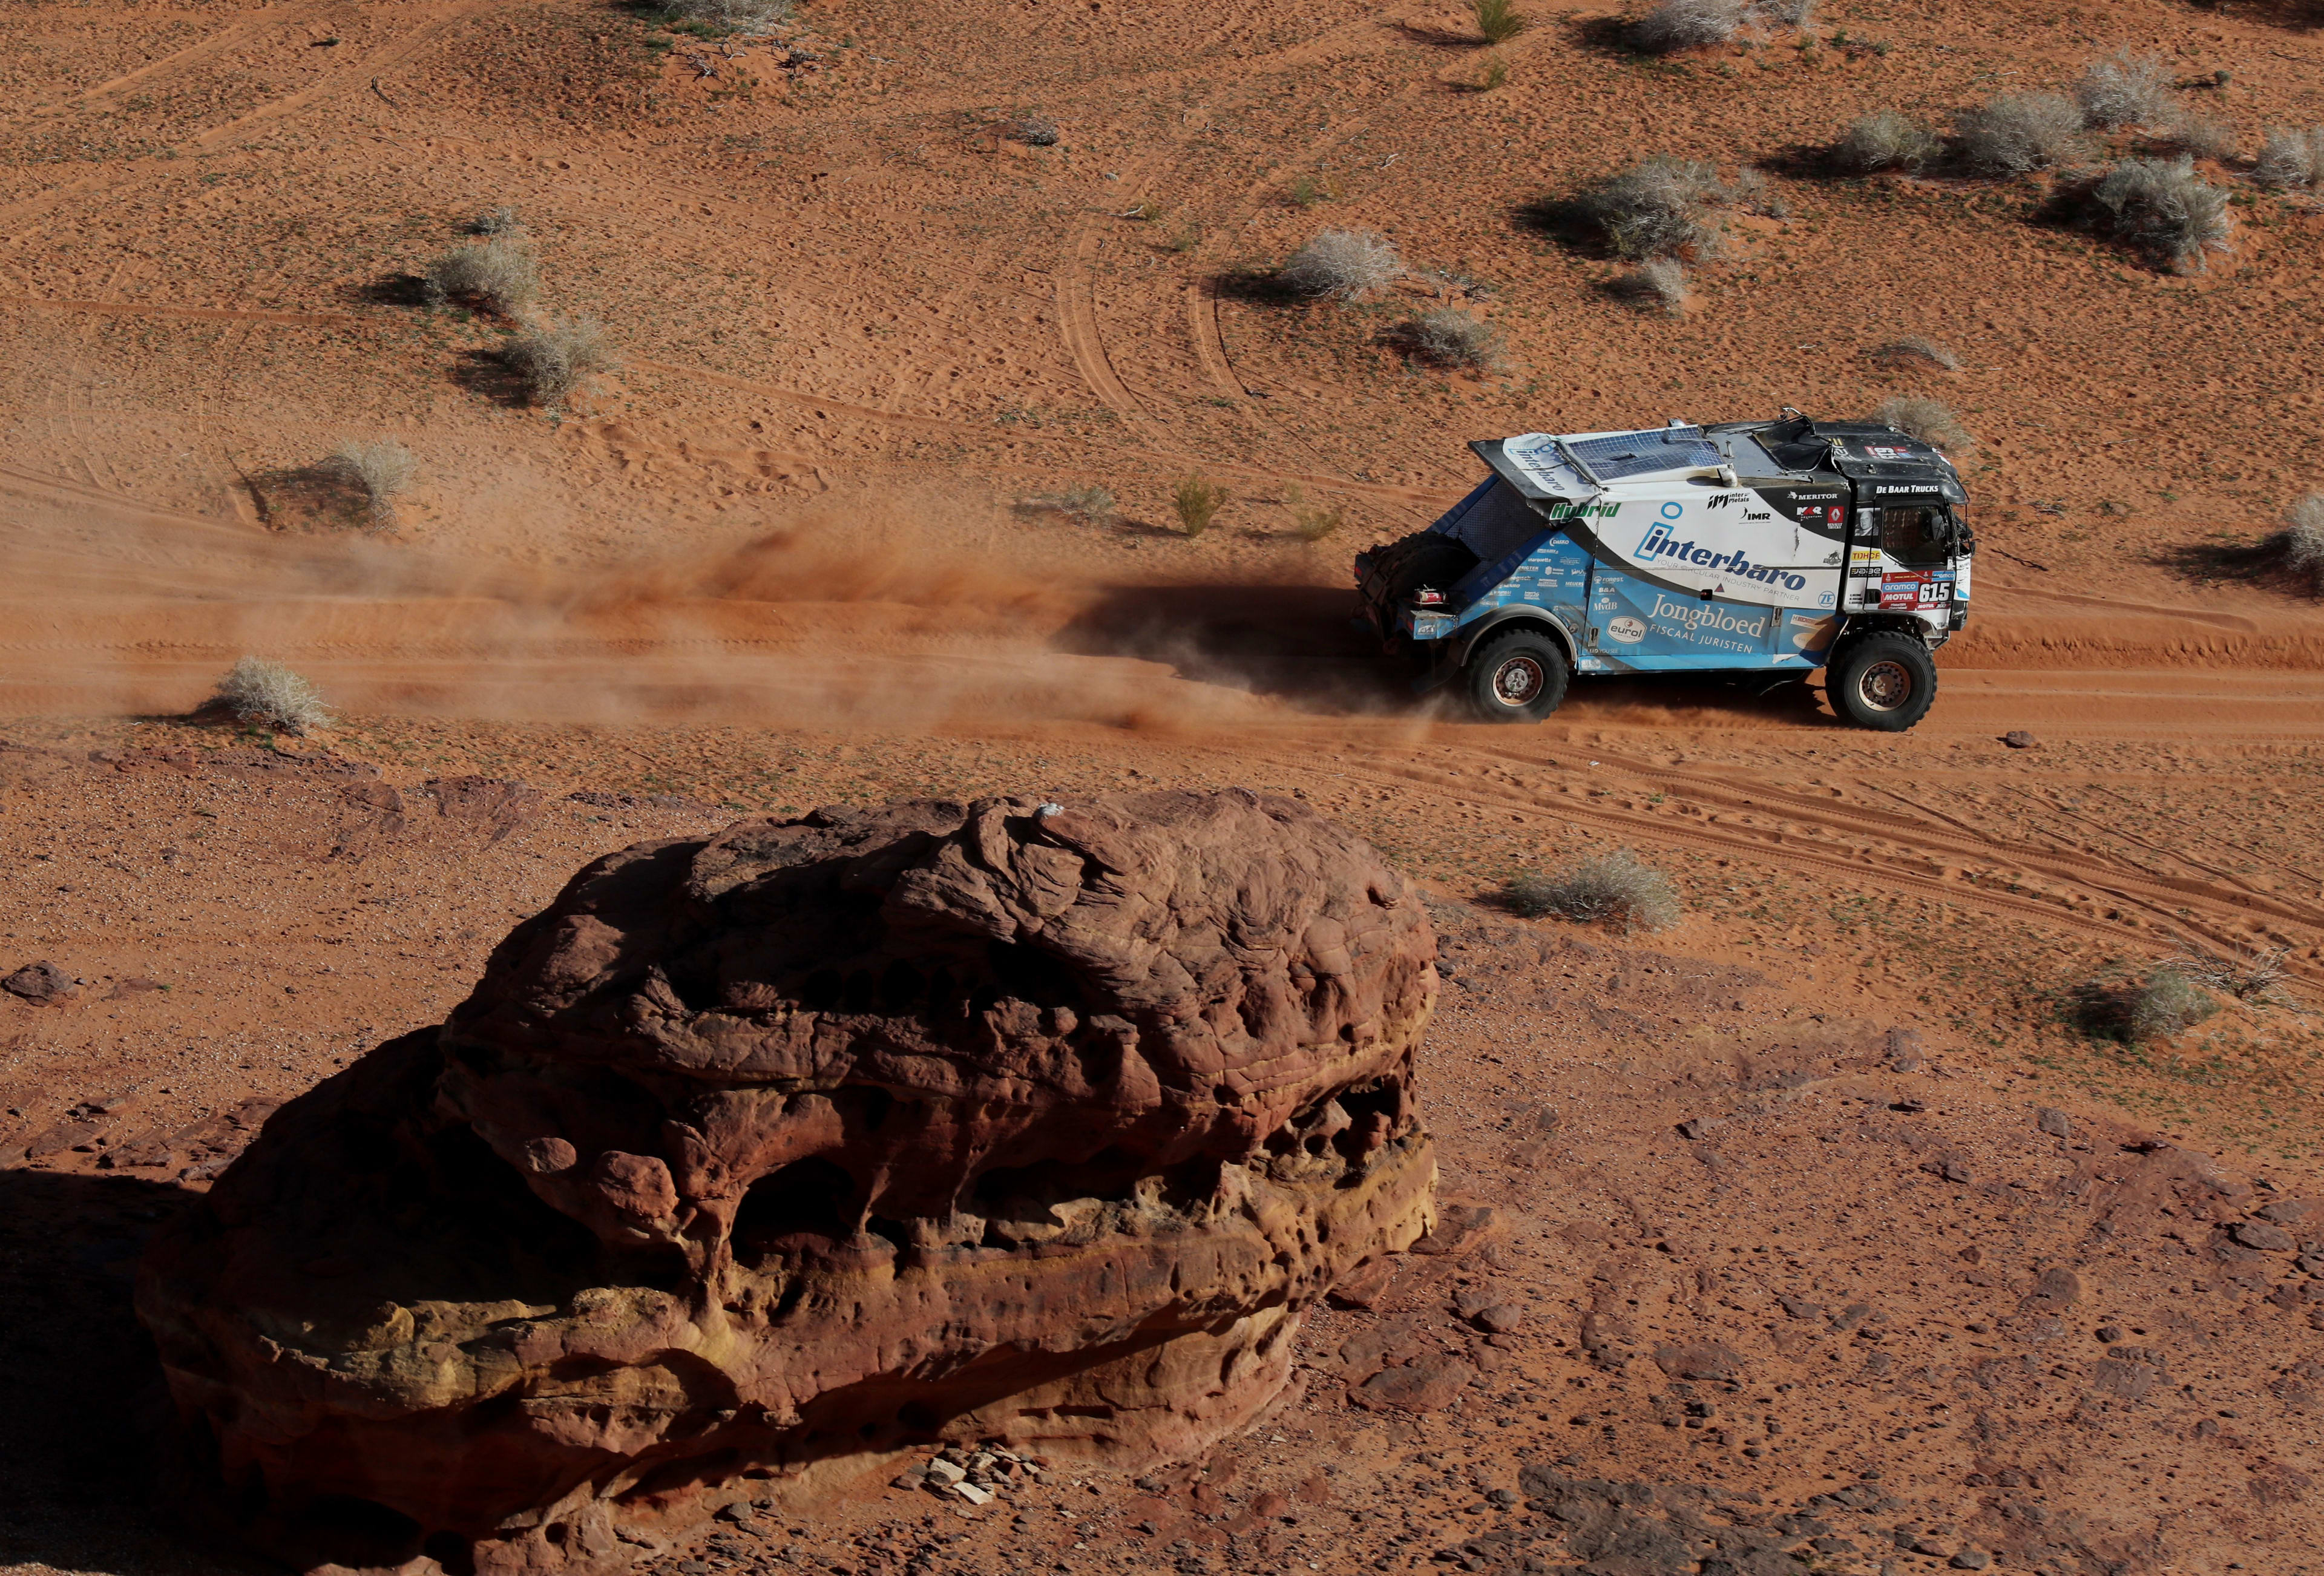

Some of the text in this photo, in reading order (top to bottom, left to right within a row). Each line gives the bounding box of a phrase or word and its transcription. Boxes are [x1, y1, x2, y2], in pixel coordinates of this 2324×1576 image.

[1550, 502, 1622, 524] Hybrid
[1644, 529, 1806, 591] interbaro
[1656, 558, 1800, 601] YOUR CIRCULAR INDUSTRY PARTNER
[1820, 594, 1834, 604] ZF
[1919, 582, 1950, 602] 615
[1593, 602, 1618, 611] MvdB
[1647, 594, 1766, 638] Jongbloed
[1610, 625, 1643, 638] eurol
[1649, 623, 1753, 654] FISCAAL JURISTEN
